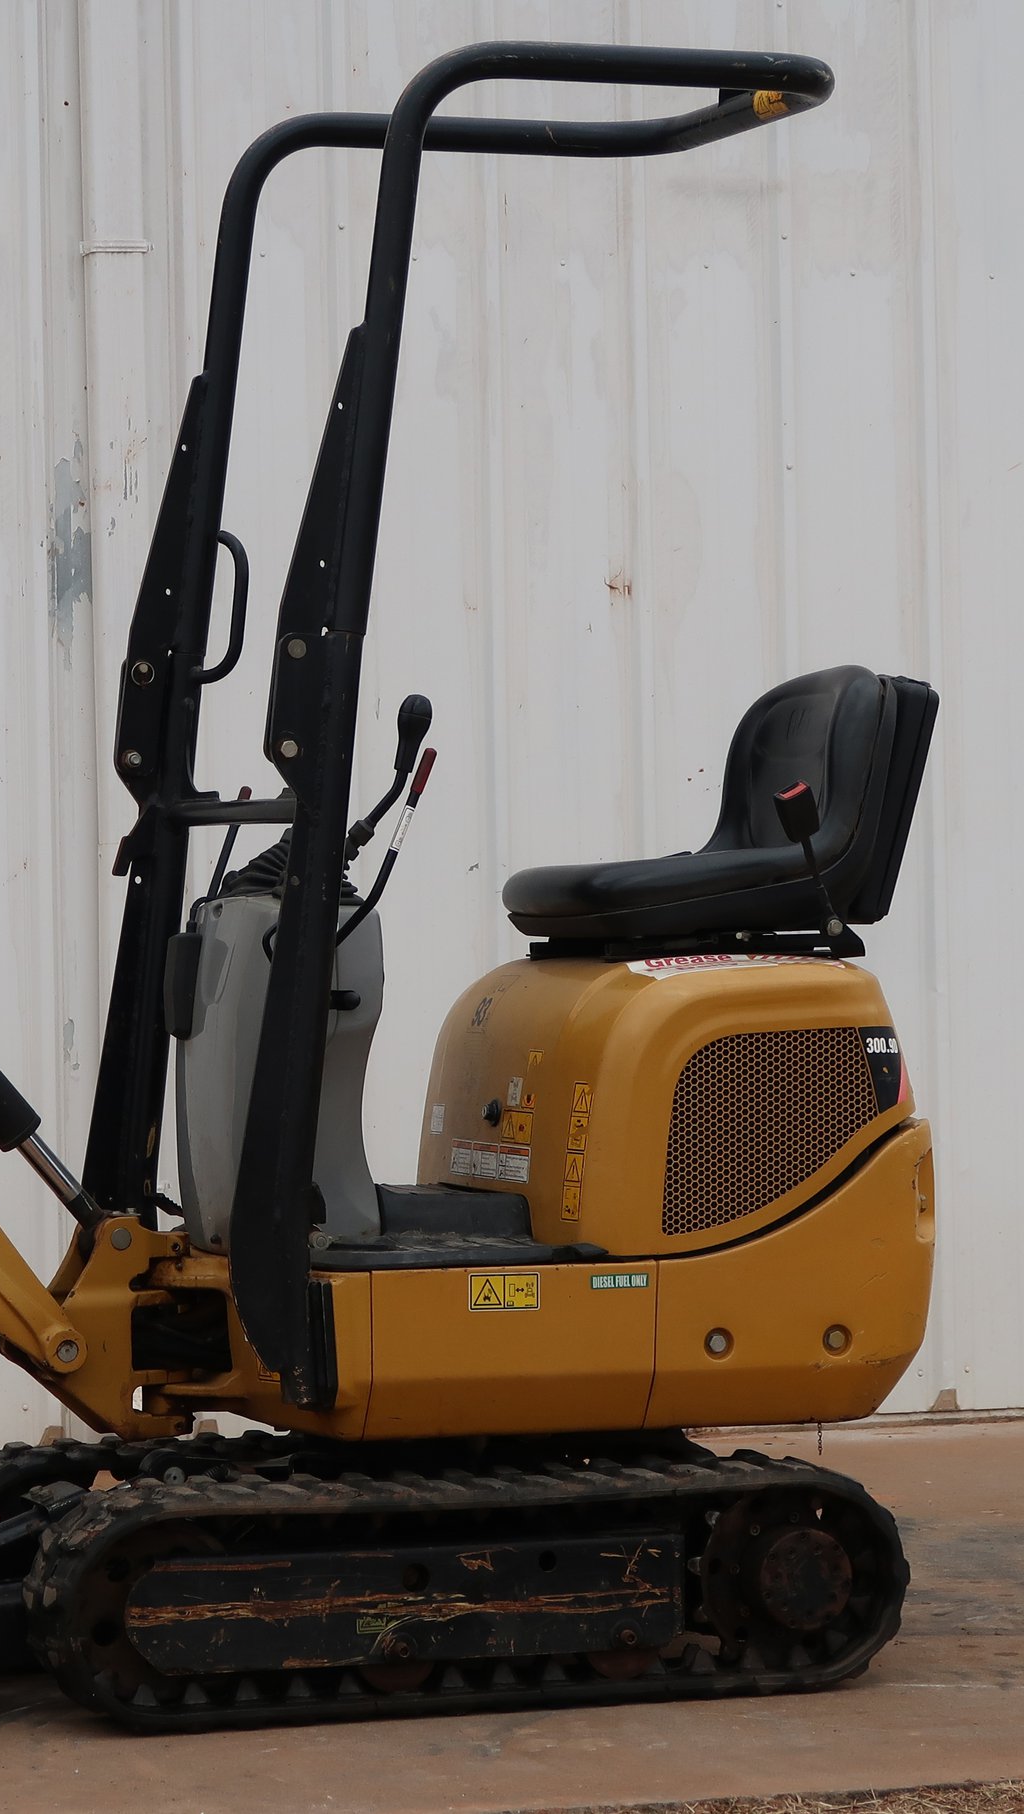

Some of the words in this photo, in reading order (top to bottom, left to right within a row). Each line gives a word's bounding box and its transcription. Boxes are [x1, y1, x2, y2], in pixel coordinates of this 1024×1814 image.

[644, 954, 732, 968] Grease
[592, 1276, 614, 1288] DIESEL
[615, 1275, 631, 1287] FUEL
[632, 1275, 647, 1287] ONLY
